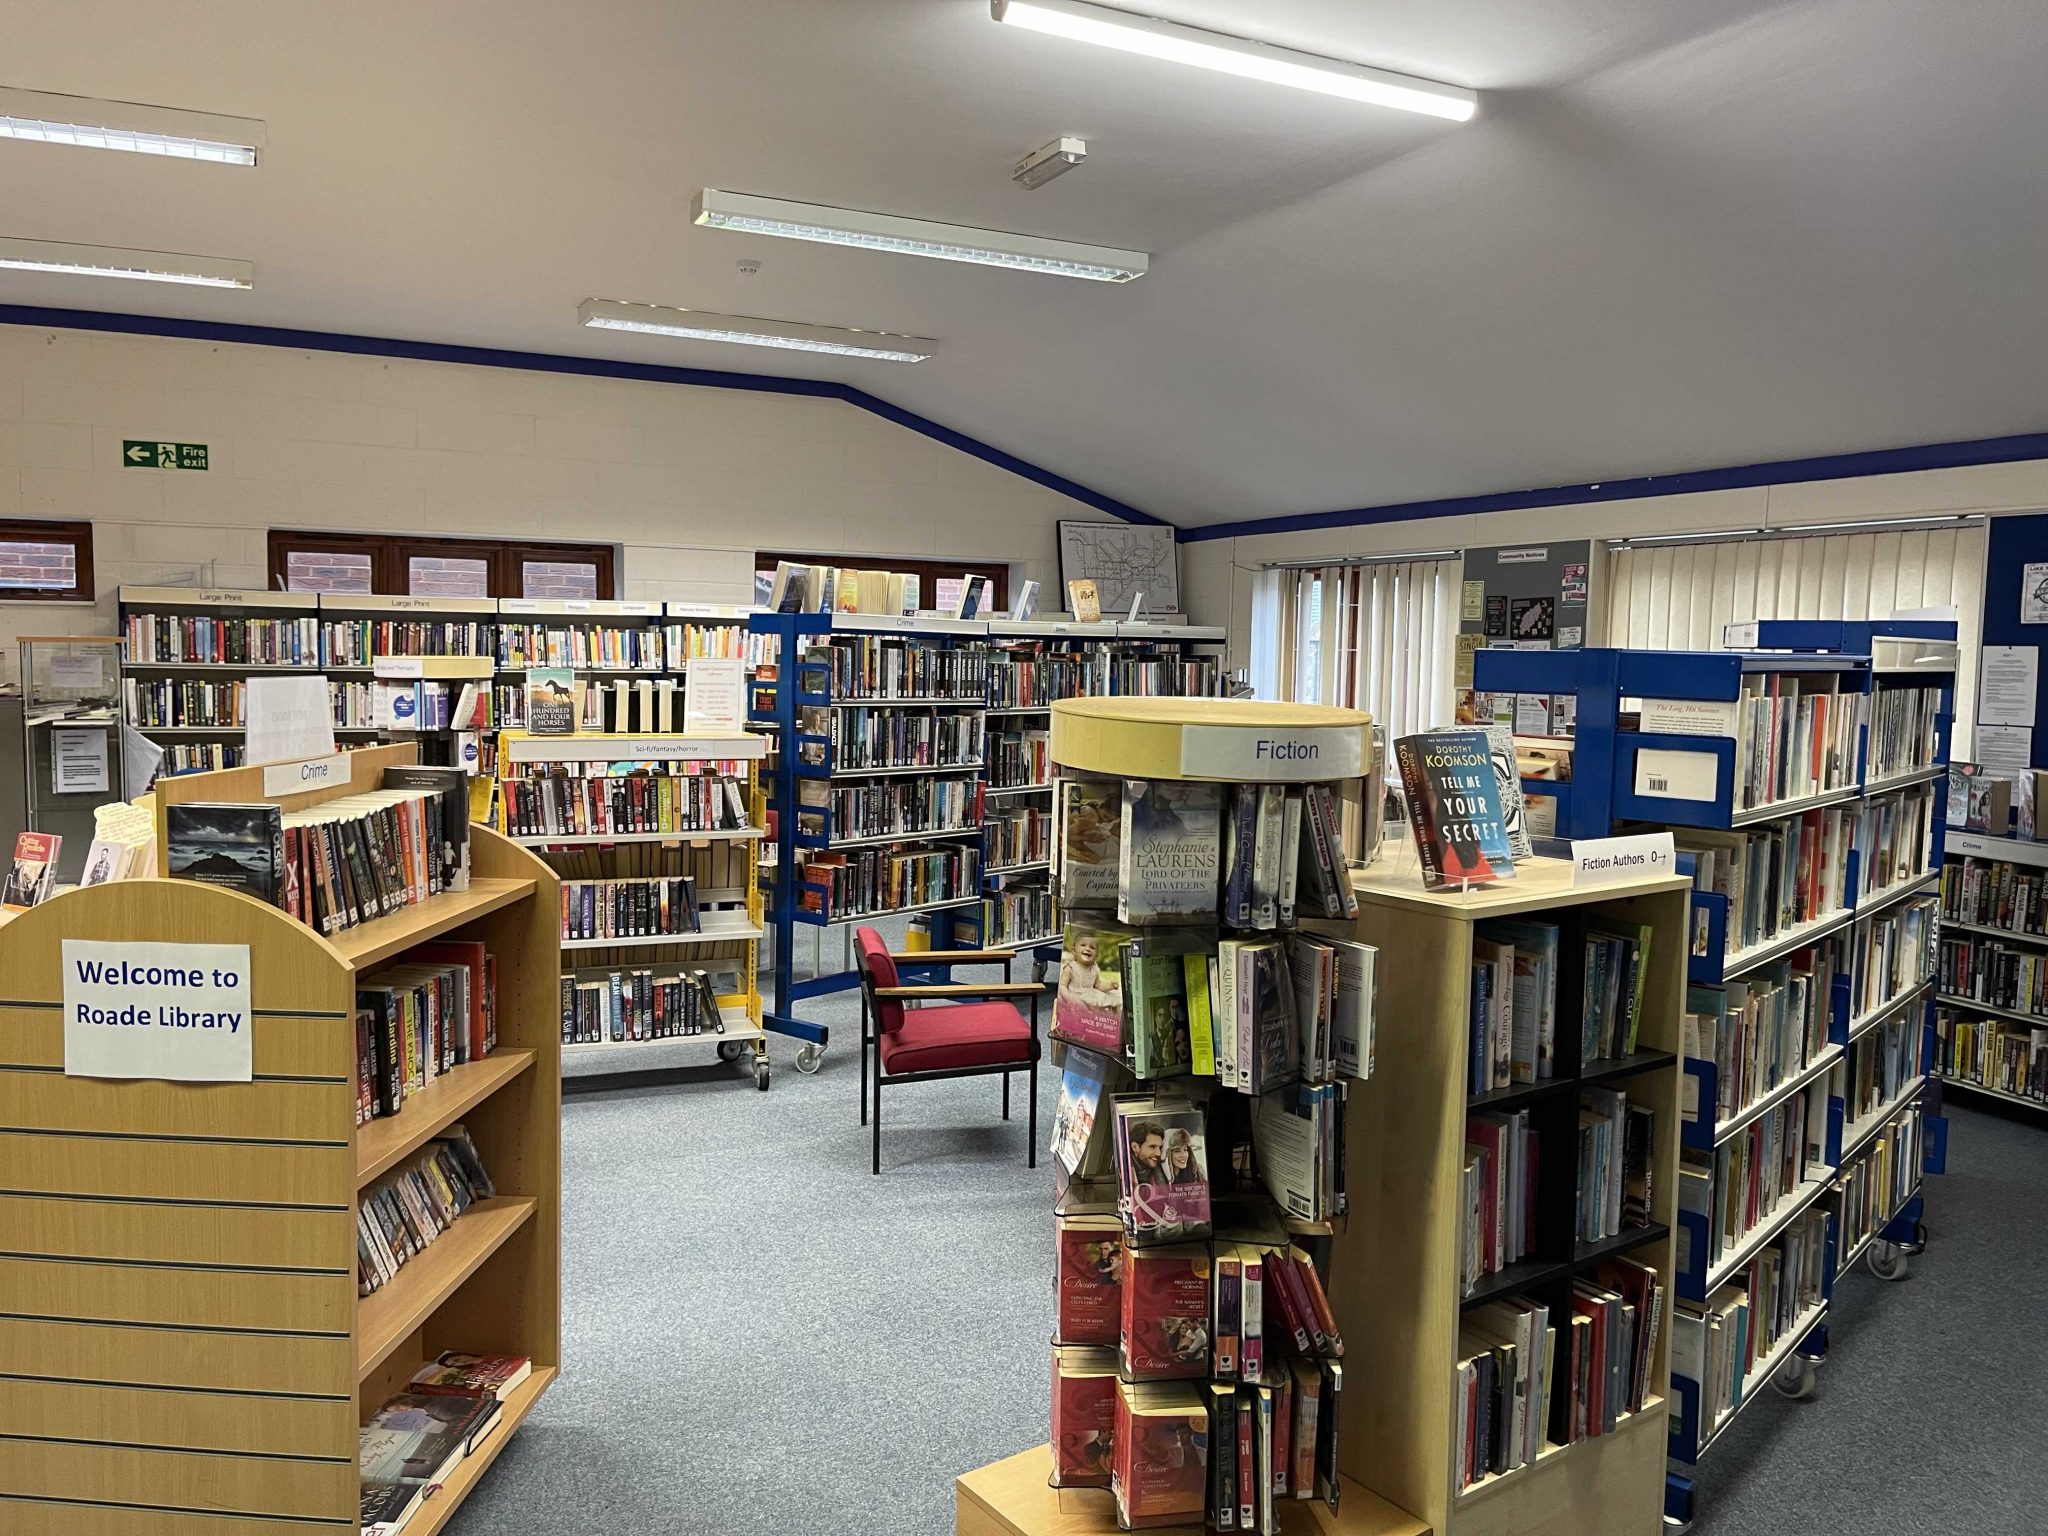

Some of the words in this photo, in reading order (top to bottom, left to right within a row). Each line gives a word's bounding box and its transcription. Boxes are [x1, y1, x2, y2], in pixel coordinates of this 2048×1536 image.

[183, 446, 206, 456] Fire
[183, 458, 206, 467] exit
[199, 593, 221, 602] Large
[897, 619, 914, 627] Crime
[1256, 740, 1319, 760] Fiction
[1436, 745, 1472, 753] DOROTHY
[1425, 753, 1487, 768] KOOMSON
[301, 764, 328, 781] Crime
[1399, 744, 1415, 796] KOOMSON
[1441, 776, 1463, 789] TELL
[1466, 776, 1480, 788] ME
[1443, 797, 1488, 816] YOUR
[1442, 822, 1498, 843] SECRET
[1142, 835, 1208, 857] Stephanie
[1962, 842, 1982, 850] Crime
[273, 832, 283, 878] OLSEN
[1137, 855, 1215, 868] LAURENS
[1582, 857, 1610, 870] Fiction
[1613, 853, 1645, 866] Authors
[1073, 868, 1105, 879] Courted
[1108, 868, 1119, 881] by
[1142, 869, 1166, 879] LORD
[1170, 869, 1186, 878] OF
[1187, 869, 1210, 878] THE
[1086, 880, 1119, 890] Captain
[1146, 881, 1205, 890] PRIVATEERS
[77, 960, 204, 988] Welcome
[212, 969, 238, 987] to
[613, 977, 621, 995] DEAN
[1626, 998, 1634, 1019] CUT
[77, 1004, 151, 1026] Roade
[159, 1005, 242, 1033] Library
[1499, 1005, 1510, 1050] Courage
[389, 1019, 397, 1065] Jardine
[362, 1074, 370, 1106] FIRE
[1064, 1276, 1098, 1288] Desire
[1134, 1356, 1170, 1369] Desire
[1134, 1462, 1168, 1473] Desire
